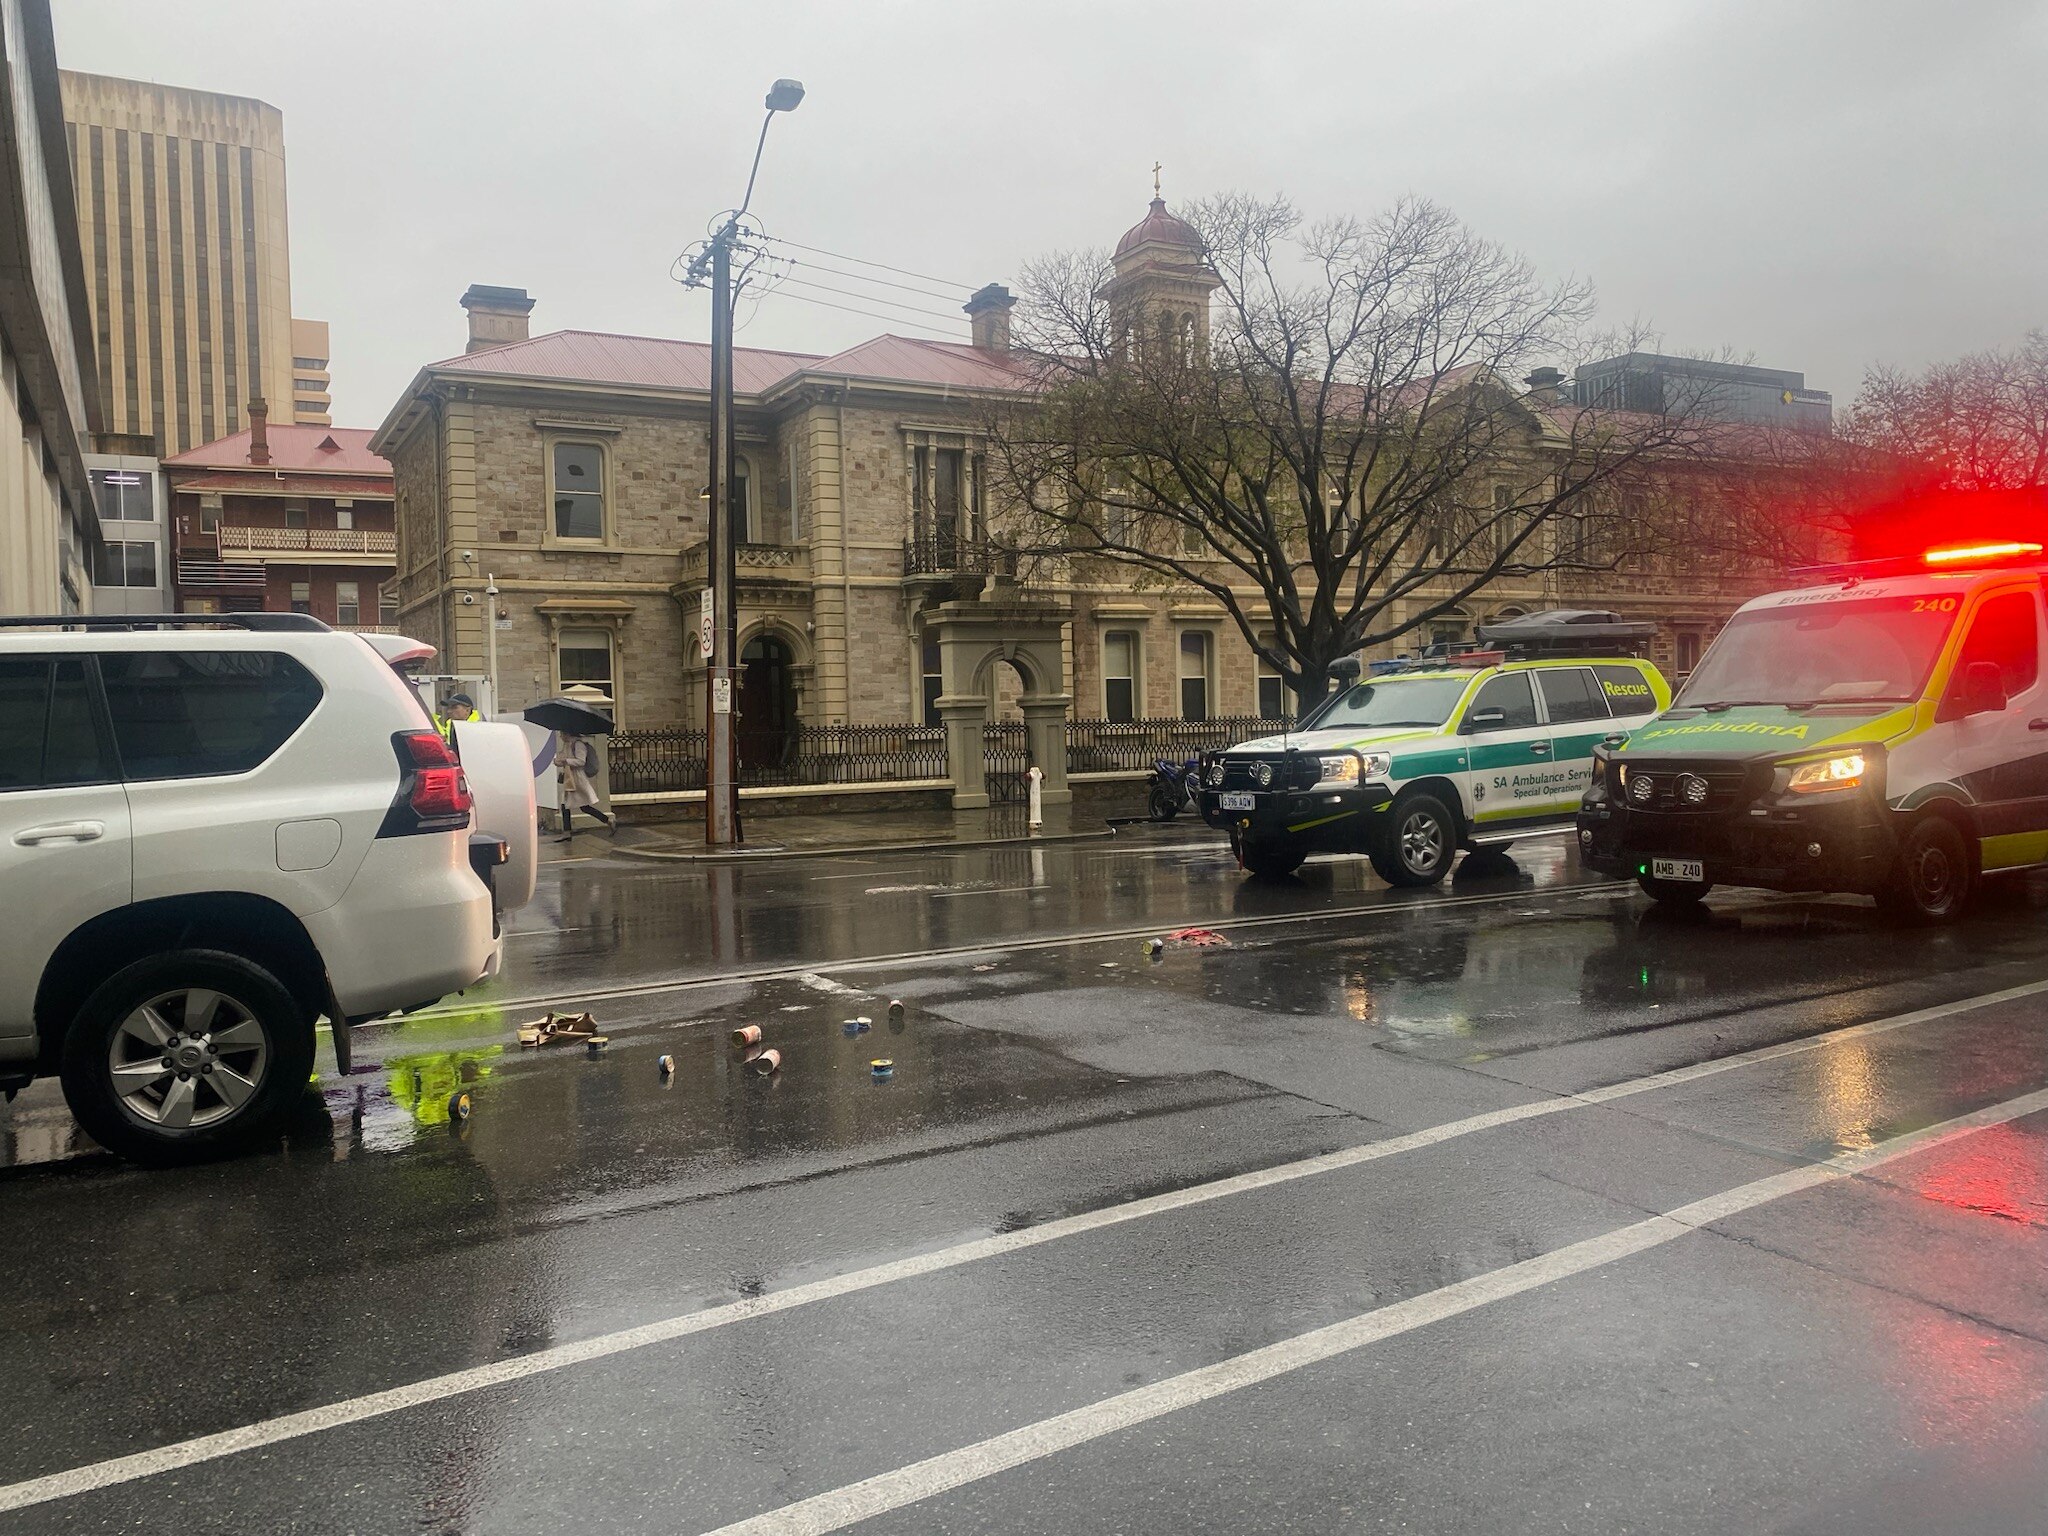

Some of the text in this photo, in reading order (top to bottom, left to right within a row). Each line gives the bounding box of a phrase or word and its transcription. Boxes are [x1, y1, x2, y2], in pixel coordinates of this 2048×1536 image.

[1778, 587, 1889, 606] Emergency
[1911, 597, 1957, 613] 240
[1603, 680, 1649, 696] Rescue
[1493, 776, 1507, 789] SA
[1512, 772, 1564, 787] Ambulance
[1514, 783, 1582, 800] Special Operations
[1655, 862, 1700, 877] AMB 240
